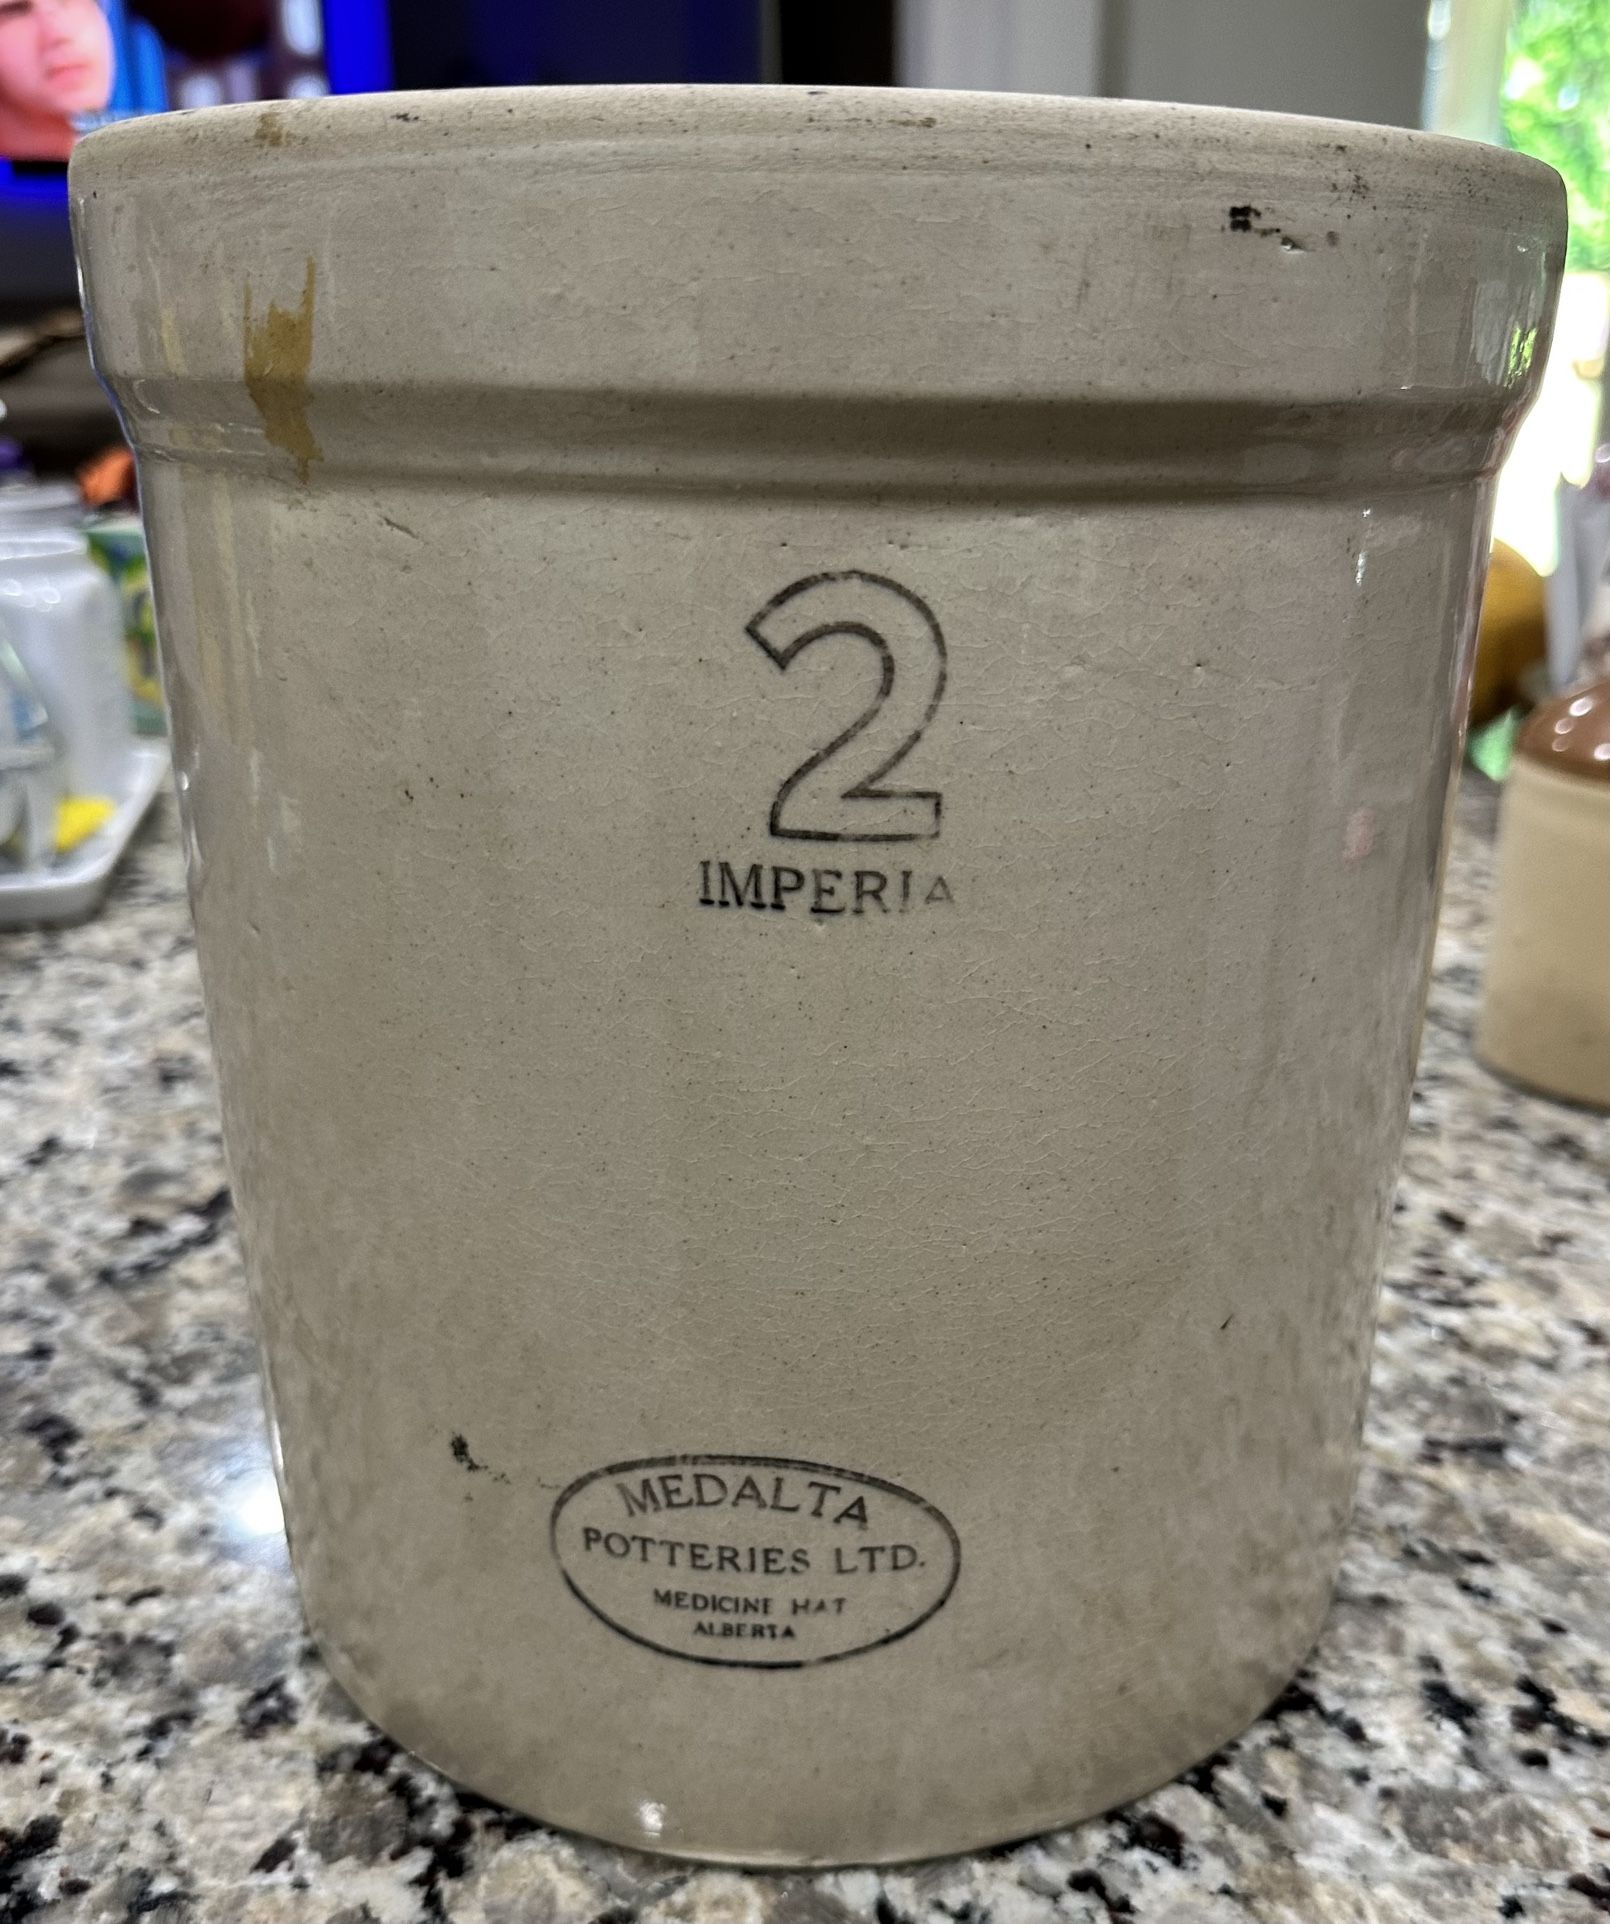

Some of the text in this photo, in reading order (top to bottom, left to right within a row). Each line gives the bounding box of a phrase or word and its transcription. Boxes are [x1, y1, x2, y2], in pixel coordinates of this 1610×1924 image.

[745, 569, 948, 842] 2
[616, 1472, 869, 1531] MEDALTA
[582, 1526, 926, 1575] POTTERIES LTD.
[652, 1588, 847, 1616] MEDICINE HAT
[693, 1621, 796, 1640] ALBERTA
